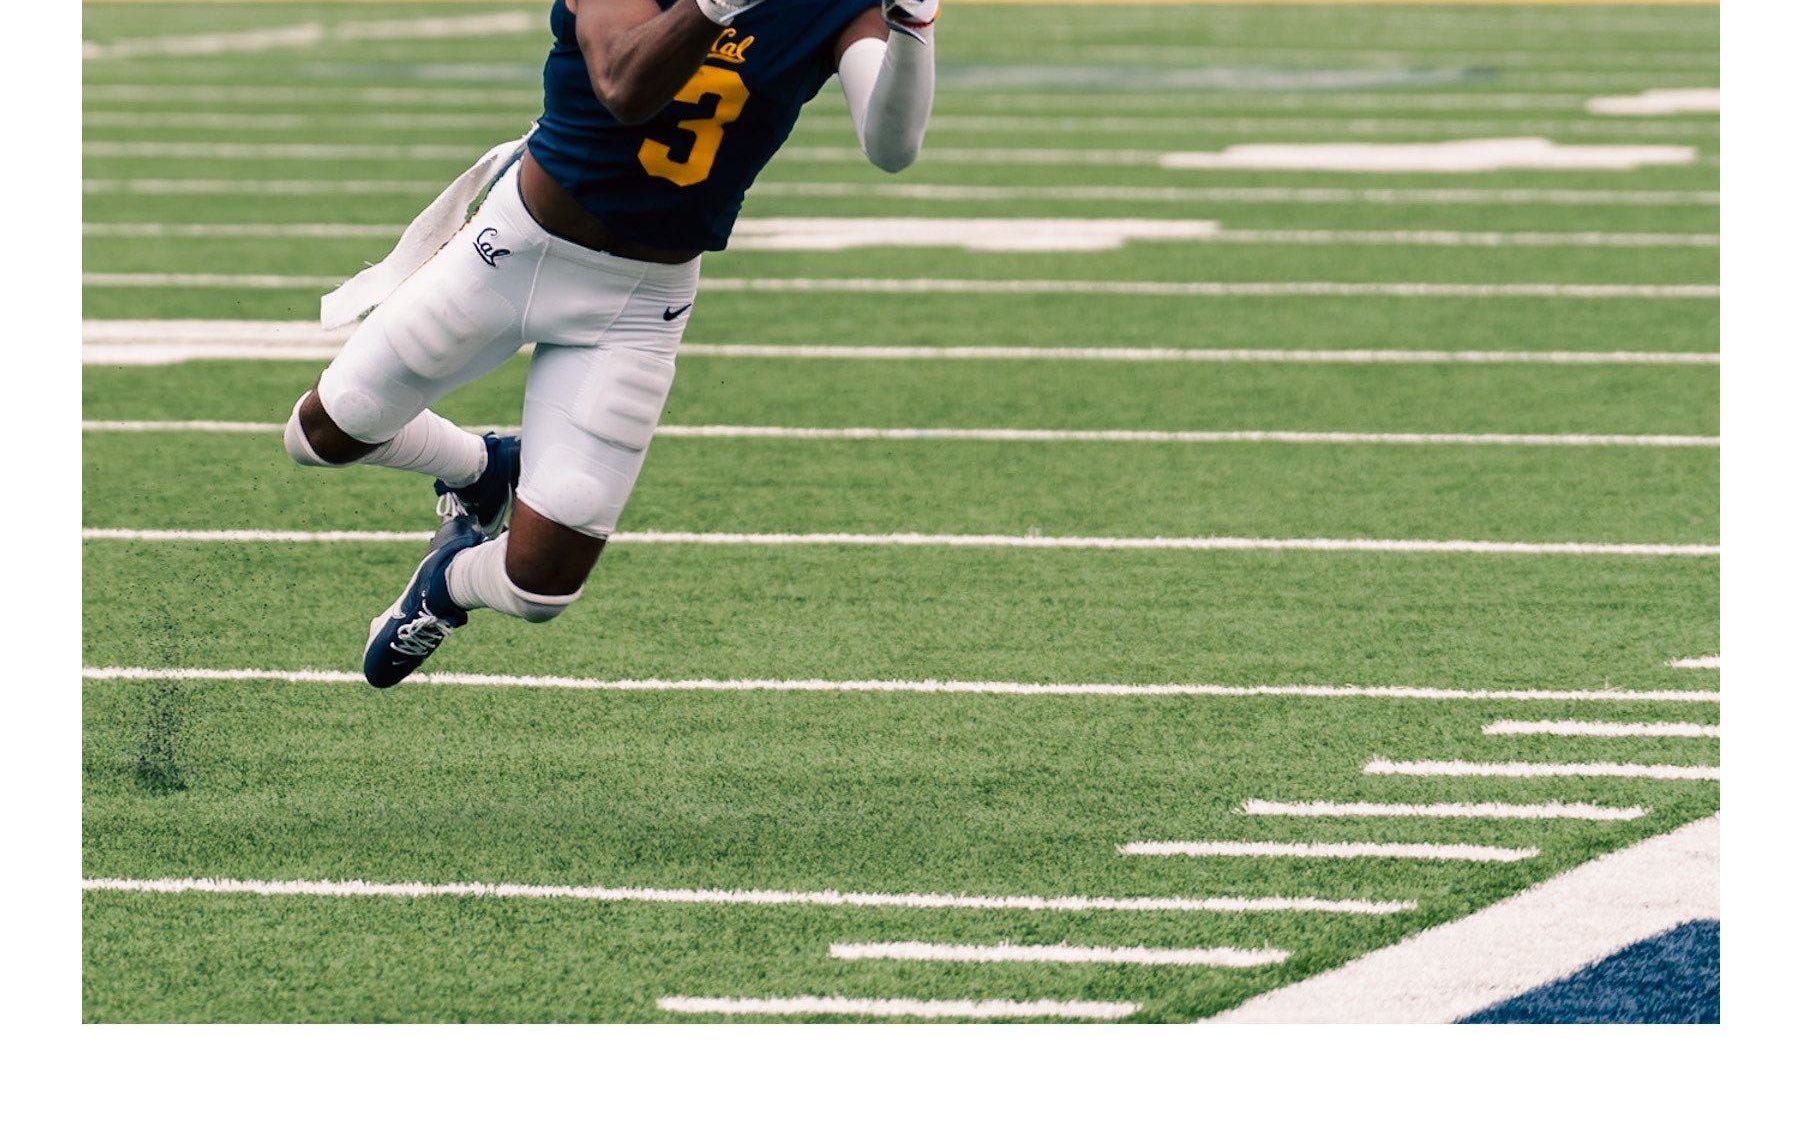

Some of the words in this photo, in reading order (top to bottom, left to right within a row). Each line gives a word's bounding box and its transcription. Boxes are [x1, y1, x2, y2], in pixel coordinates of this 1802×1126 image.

[707, 27, 755, 64] Cal
[637, 64, 750, 187] 3
[473, 227, 511, 267] Cal
